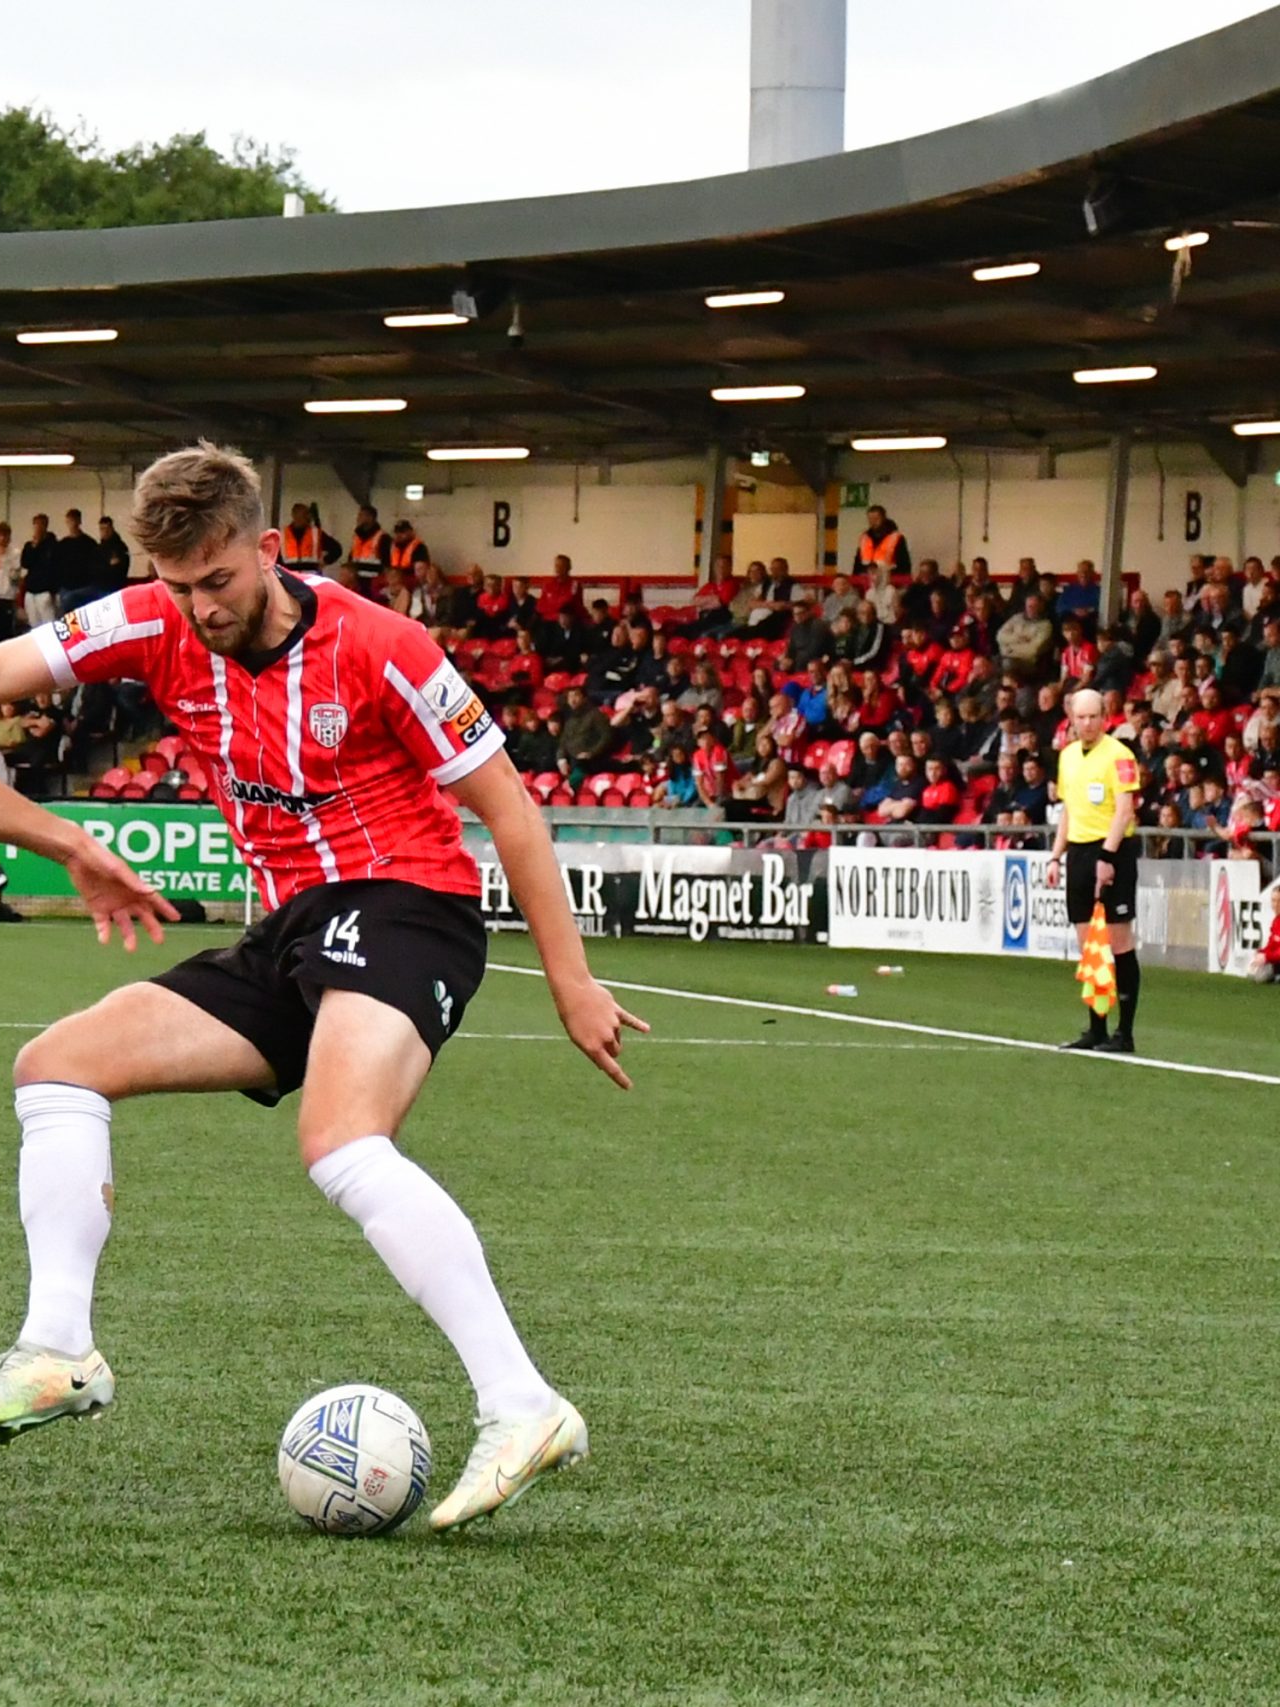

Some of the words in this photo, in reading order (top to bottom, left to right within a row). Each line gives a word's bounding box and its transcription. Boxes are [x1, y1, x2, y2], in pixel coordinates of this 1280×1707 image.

[493, 501, 511, 547] B
[1185, 491, 1202, 542] B
[463, 709, 493, 743] CAB
[83, 820, 244, 864] ROPE
[138, 870, 222, 892] ESTATE
[634, 850, 754, 942] Magnet
[758, 853, 814, 926] Bar
[835, 865, 972, 923] NORTHBOUND
[323, 909, 361, 951] 14
